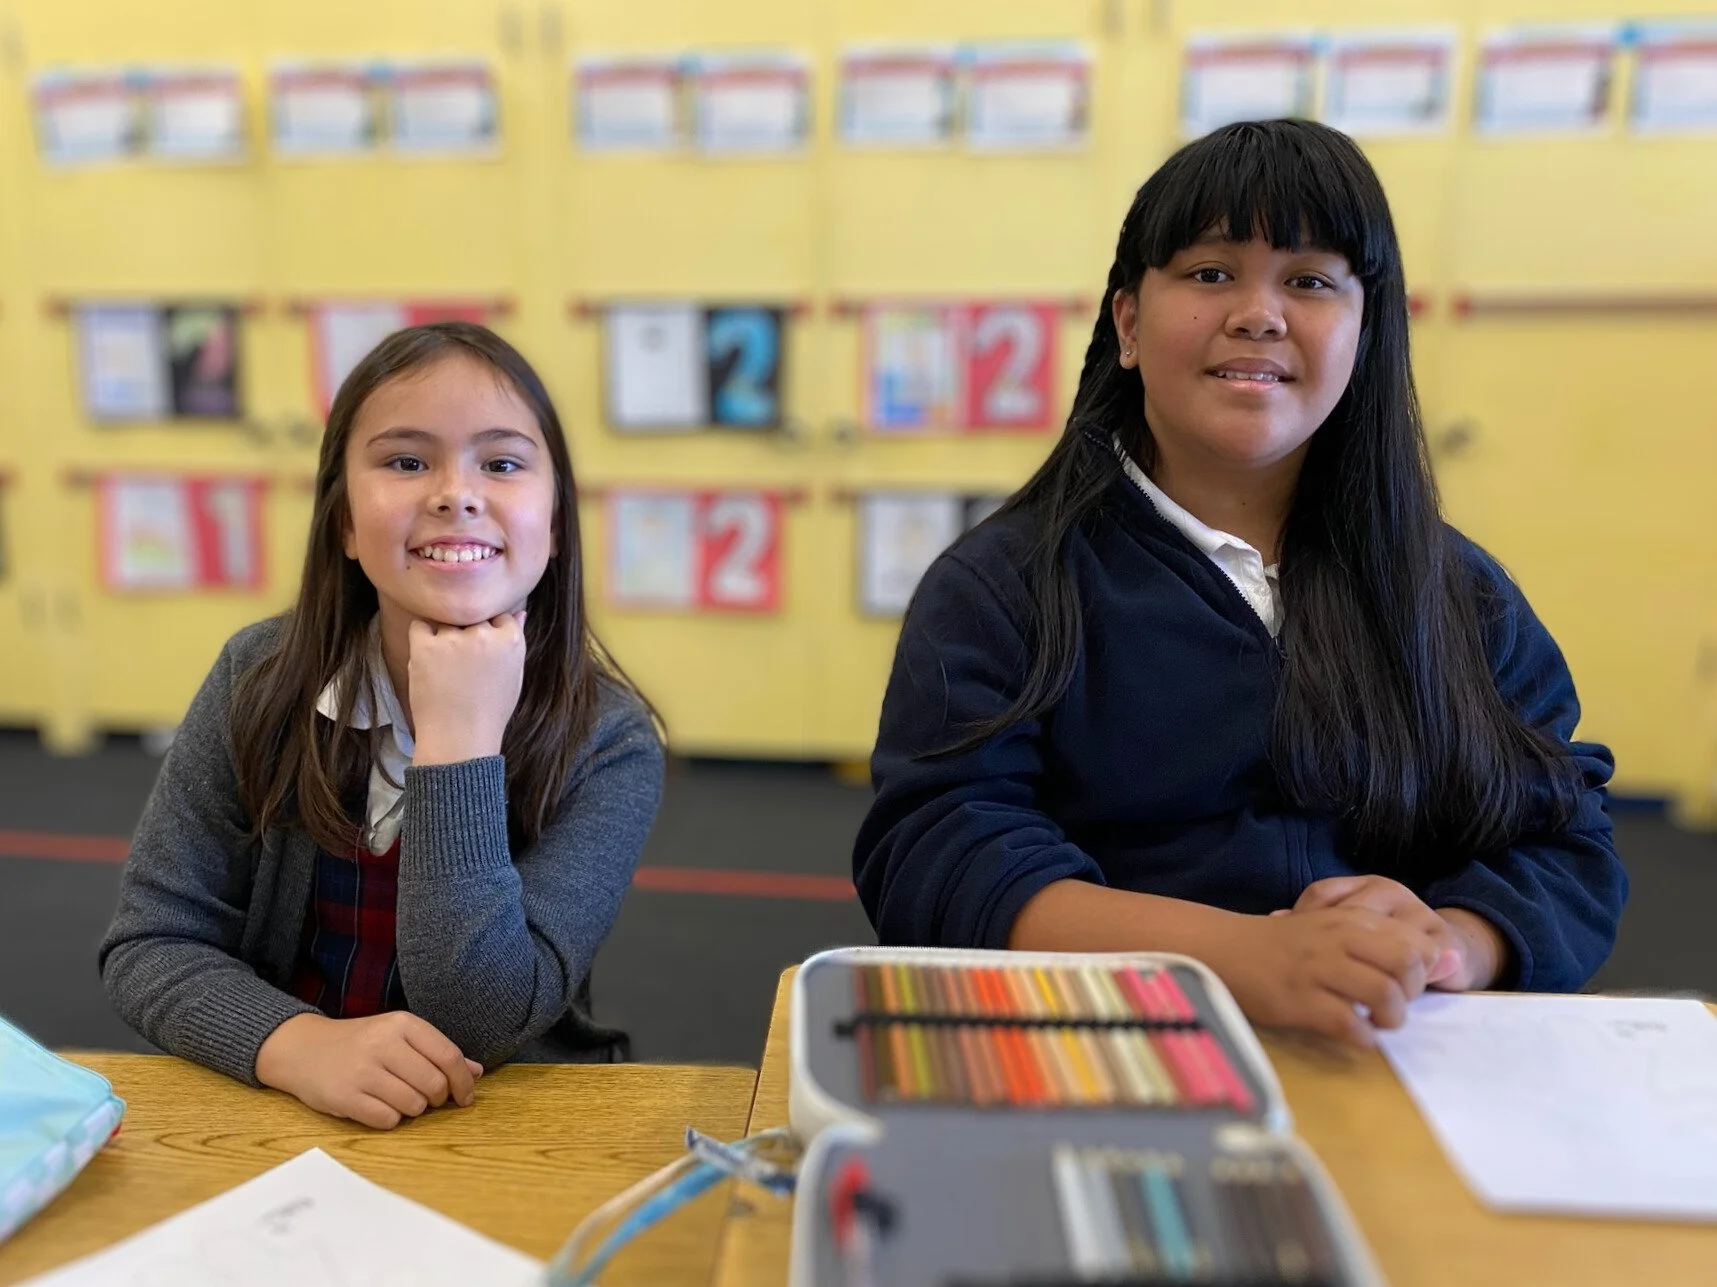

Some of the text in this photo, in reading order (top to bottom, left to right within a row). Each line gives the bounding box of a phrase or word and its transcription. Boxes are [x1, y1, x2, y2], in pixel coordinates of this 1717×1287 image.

[706, 309, 777, 424] 2
[973, 310, 1043, 419] 2
[206, 486, 250, 582] 1
[706, 499, 769, 602] 2
